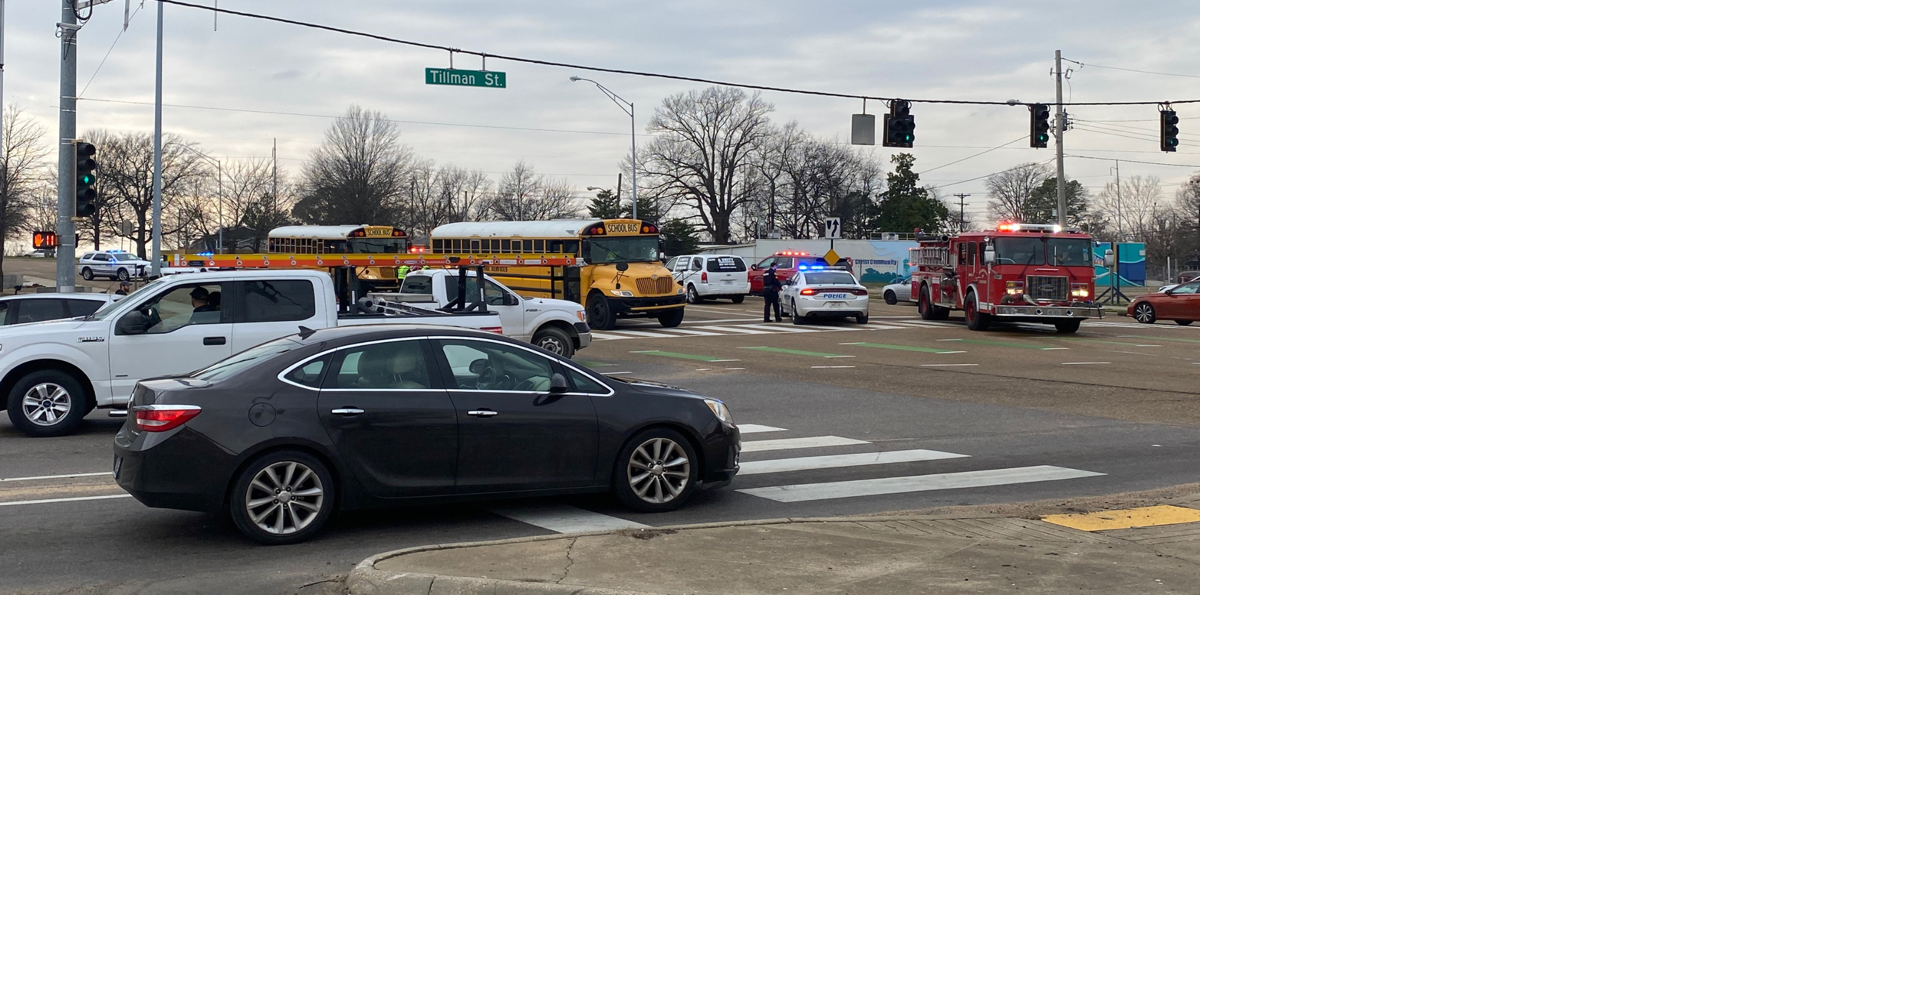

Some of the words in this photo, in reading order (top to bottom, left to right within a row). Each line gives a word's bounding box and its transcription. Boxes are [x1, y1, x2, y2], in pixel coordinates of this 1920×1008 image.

[430, 70, 475, 85] Tillman
[484, 73, 503, 87] St.
[367, 228, 381, 236] SCHOOL
[607, 223, 627, 233] SCHOOL
[628, 223, 638, 233] BUS
[46, 235, 54, 246] 11
